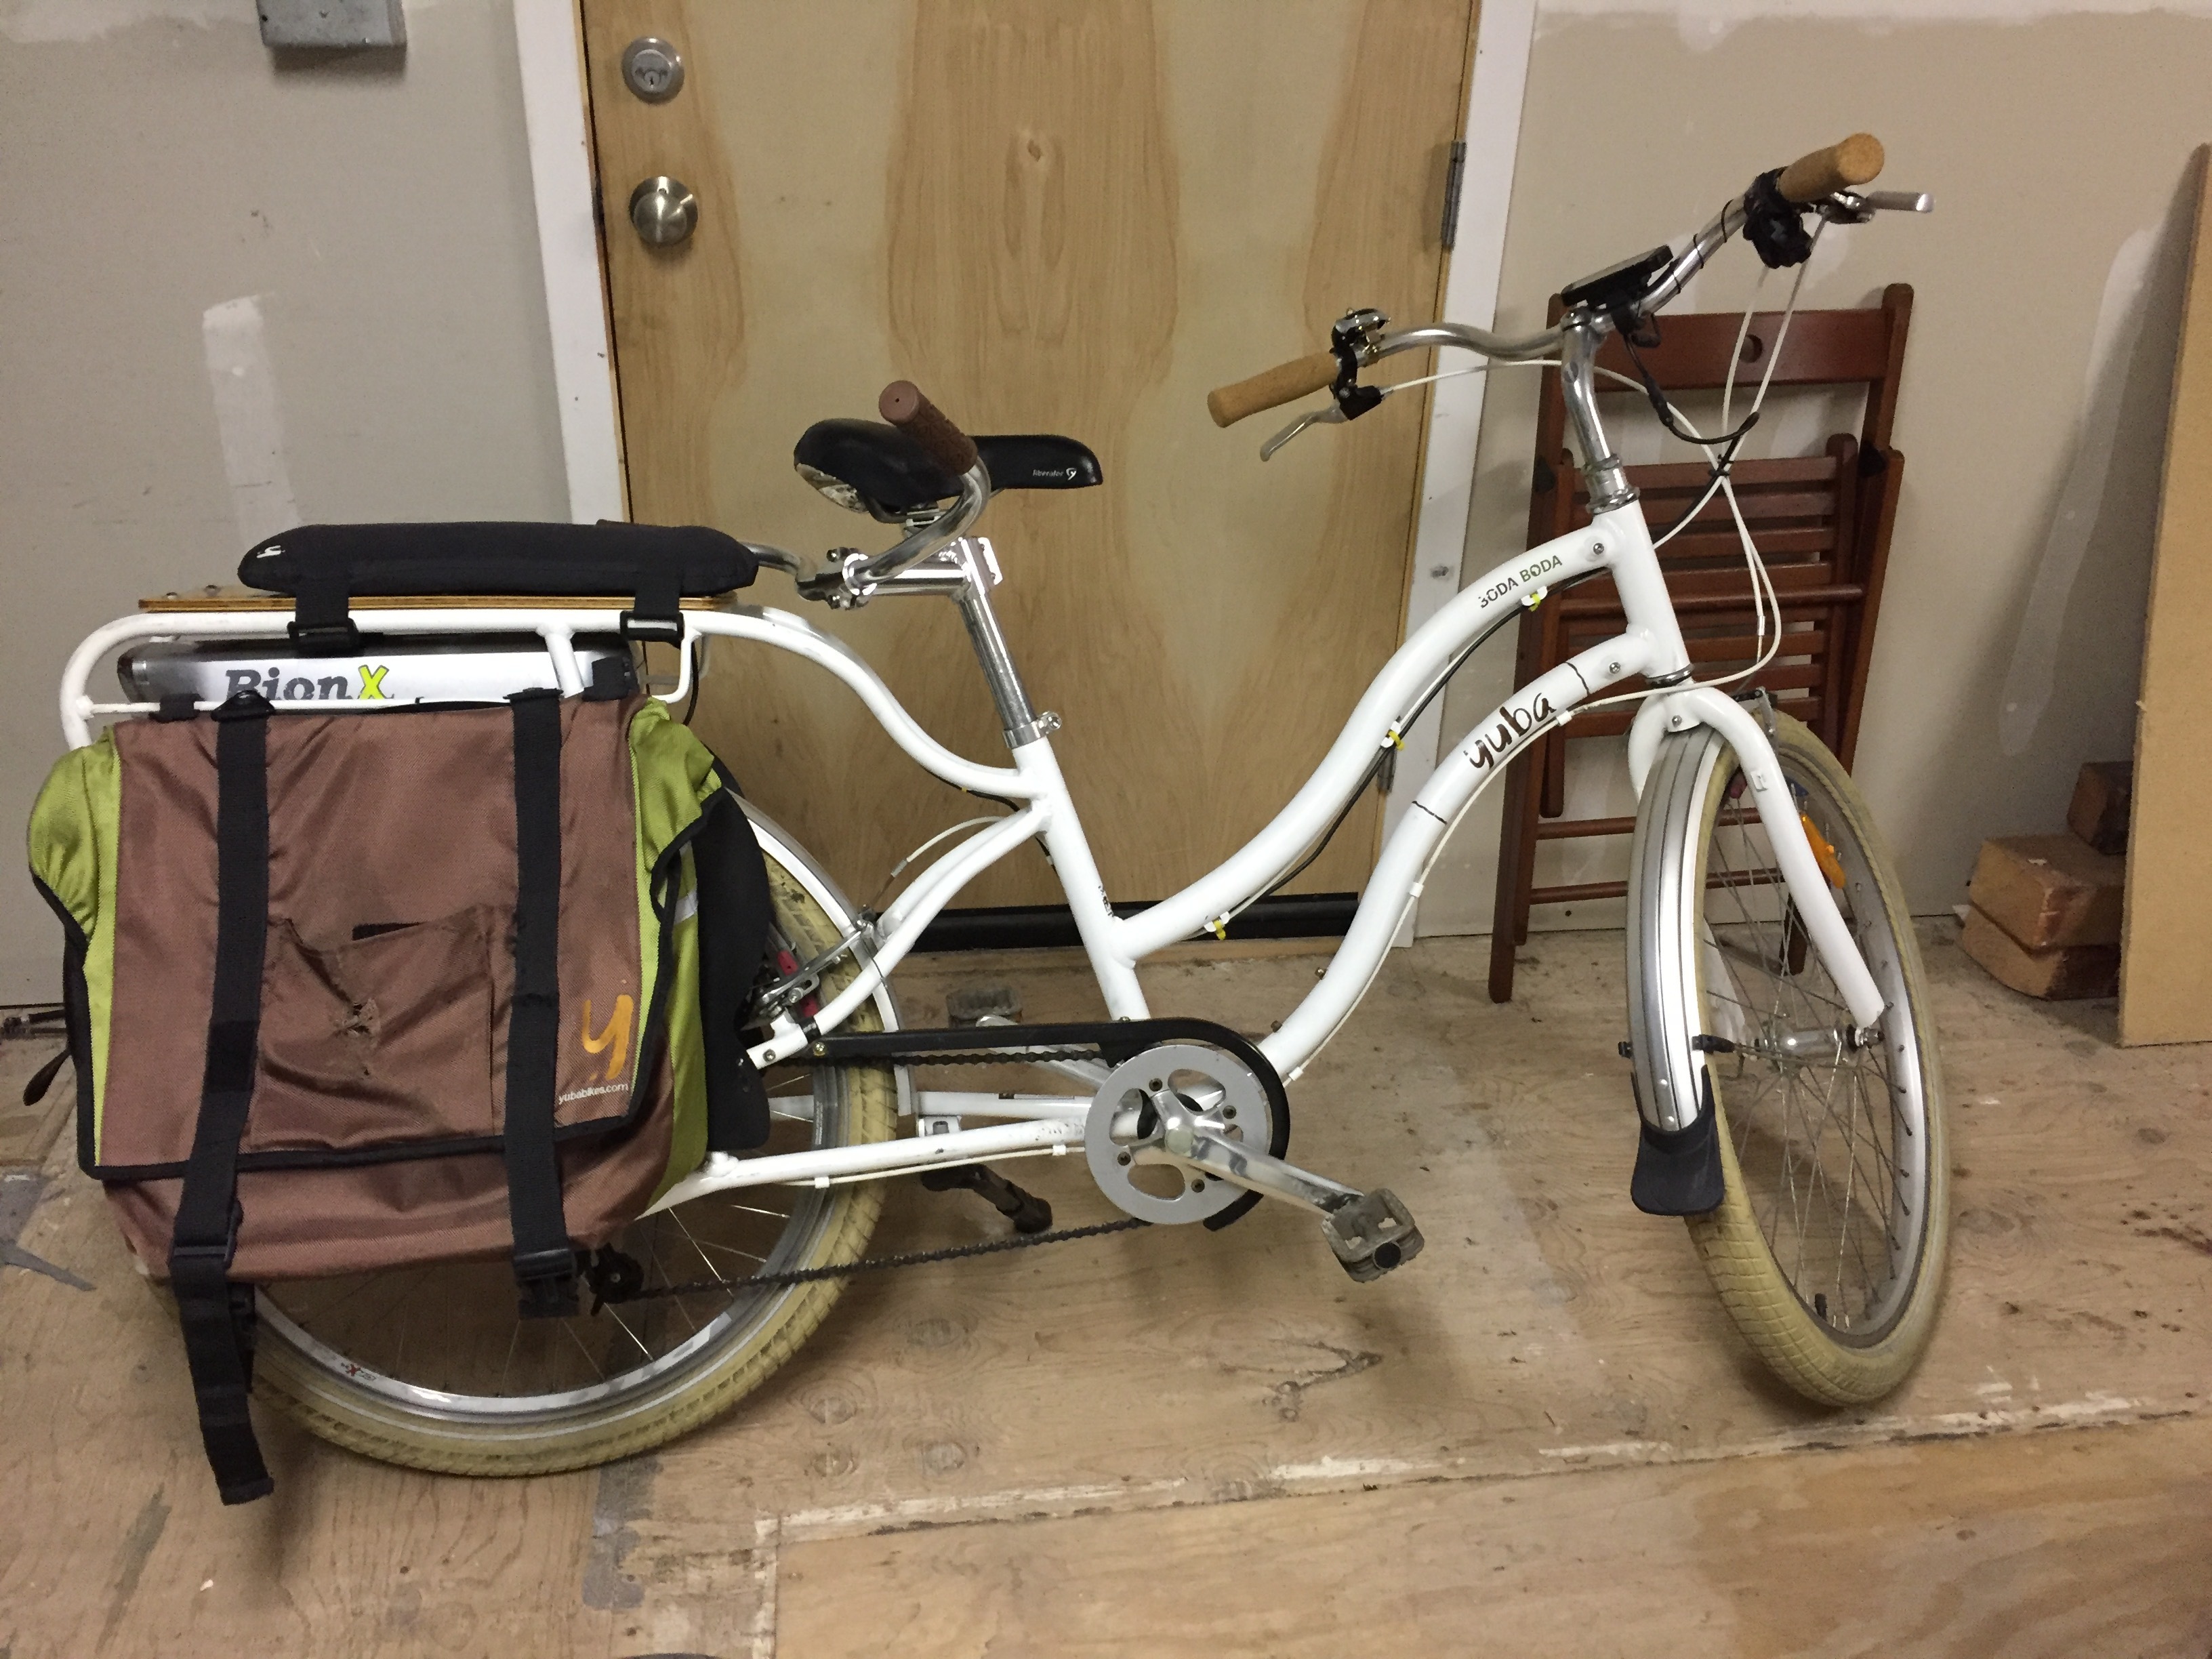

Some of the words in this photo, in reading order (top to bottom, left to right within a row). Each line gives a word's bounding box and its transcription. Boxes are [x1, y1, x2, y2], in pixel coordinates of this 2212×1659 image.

[1519, 555, 1563, 582] BODA
[226, 664, 394, 700] BionX
[1463, 693, 1557, 769] yuba
[558, 1084, 629, 1105] yubabikes.com
